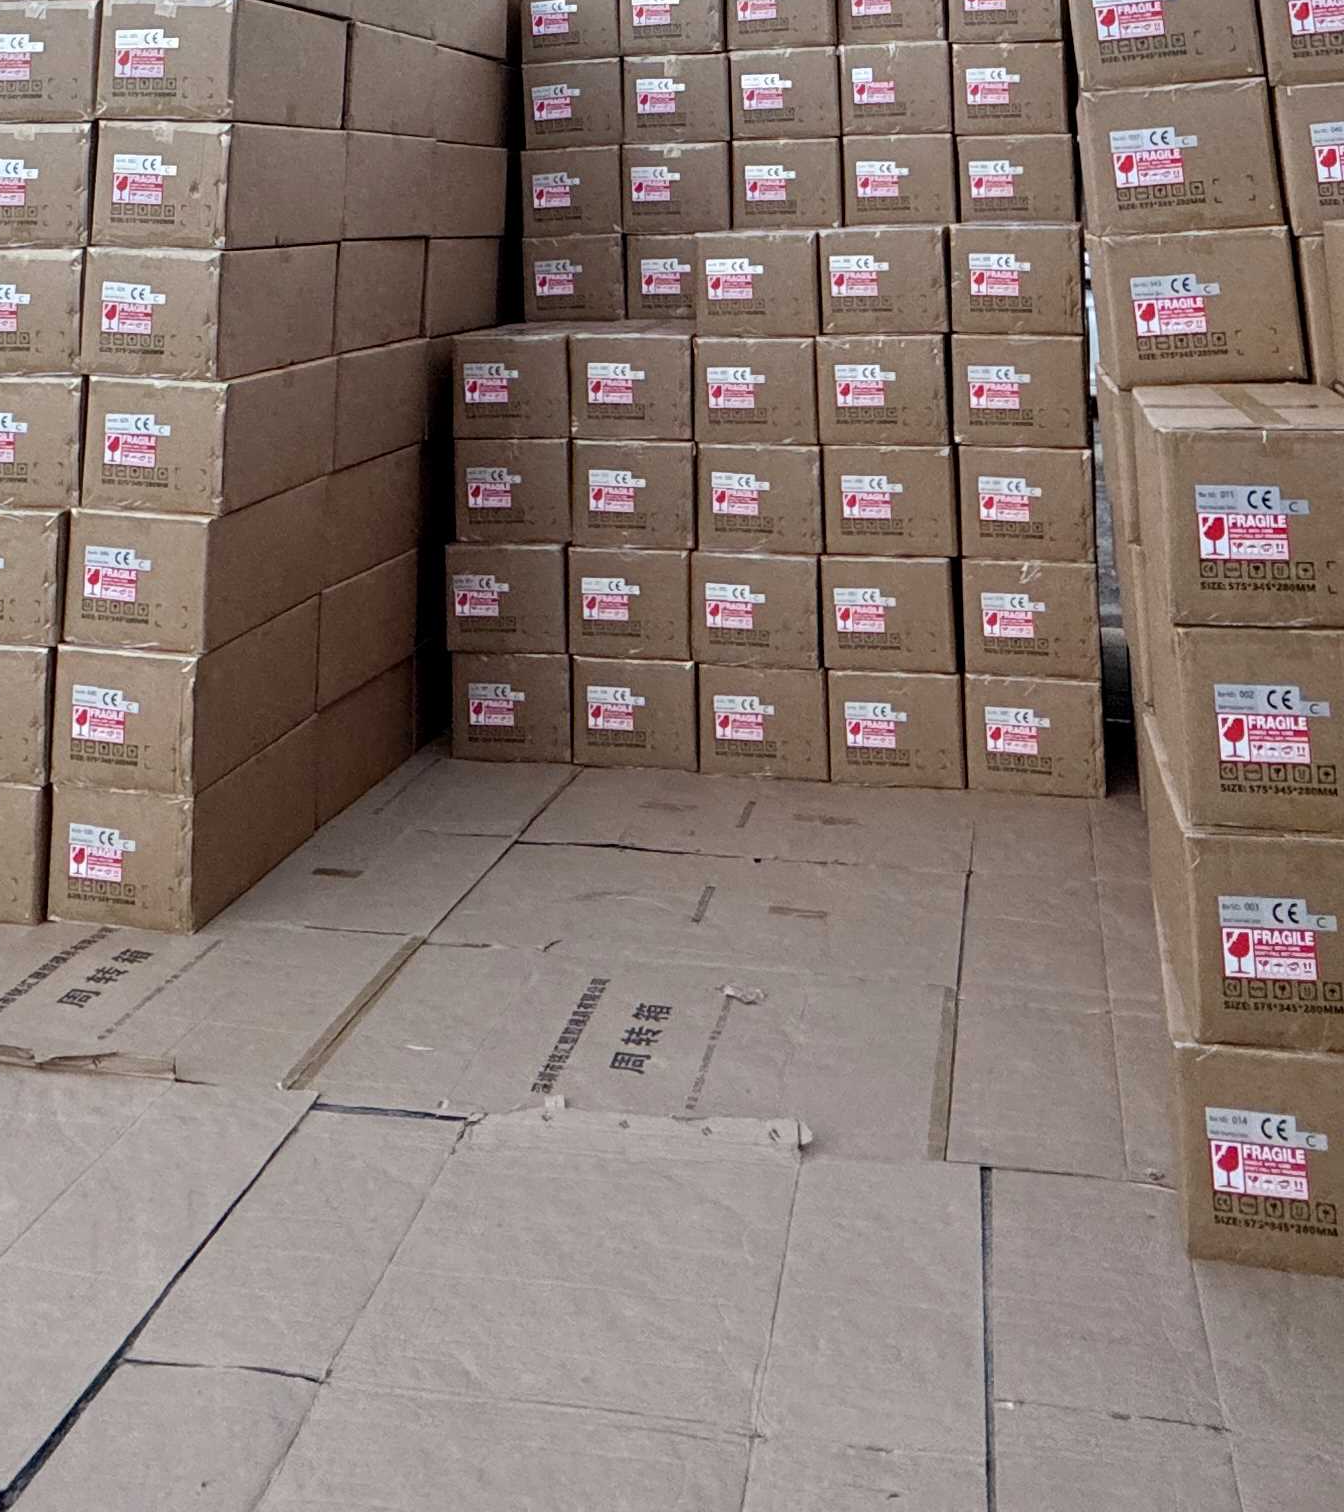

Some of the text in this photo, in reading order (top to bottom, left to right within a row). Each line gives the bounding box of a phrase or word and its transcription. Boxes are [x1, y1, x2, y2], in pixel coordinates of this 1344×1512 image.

[1115, 0, 1160, 14] FRAGILE
[1150, 131, 1169, 145] CE
[1135, 148, 1180, 161] FRAGILE
[1171, 278, 1191, 293] CE
[1157, 296, 1203, 310] FRAGILE
[1248, 491, 1272, 509] CE
[1227, 514, 1286, 527] FRAGILE
[1267, 690, 1292, 710] CE
[1247, 714, 1307, 731] FRAGILE
[1273, 903, 1299, 923] CE
[1253, 928, 1314, 945] FRAGILE
[56, 947, 155, 1009] 周转箱
[609, 1002, 673, 1075] 周转箱
[1232, 1115, 1248, 1125] 014
[1261, 1118, 1288, 1141] CE
[1243, 1143, 1306, 1164] FRAGILE
